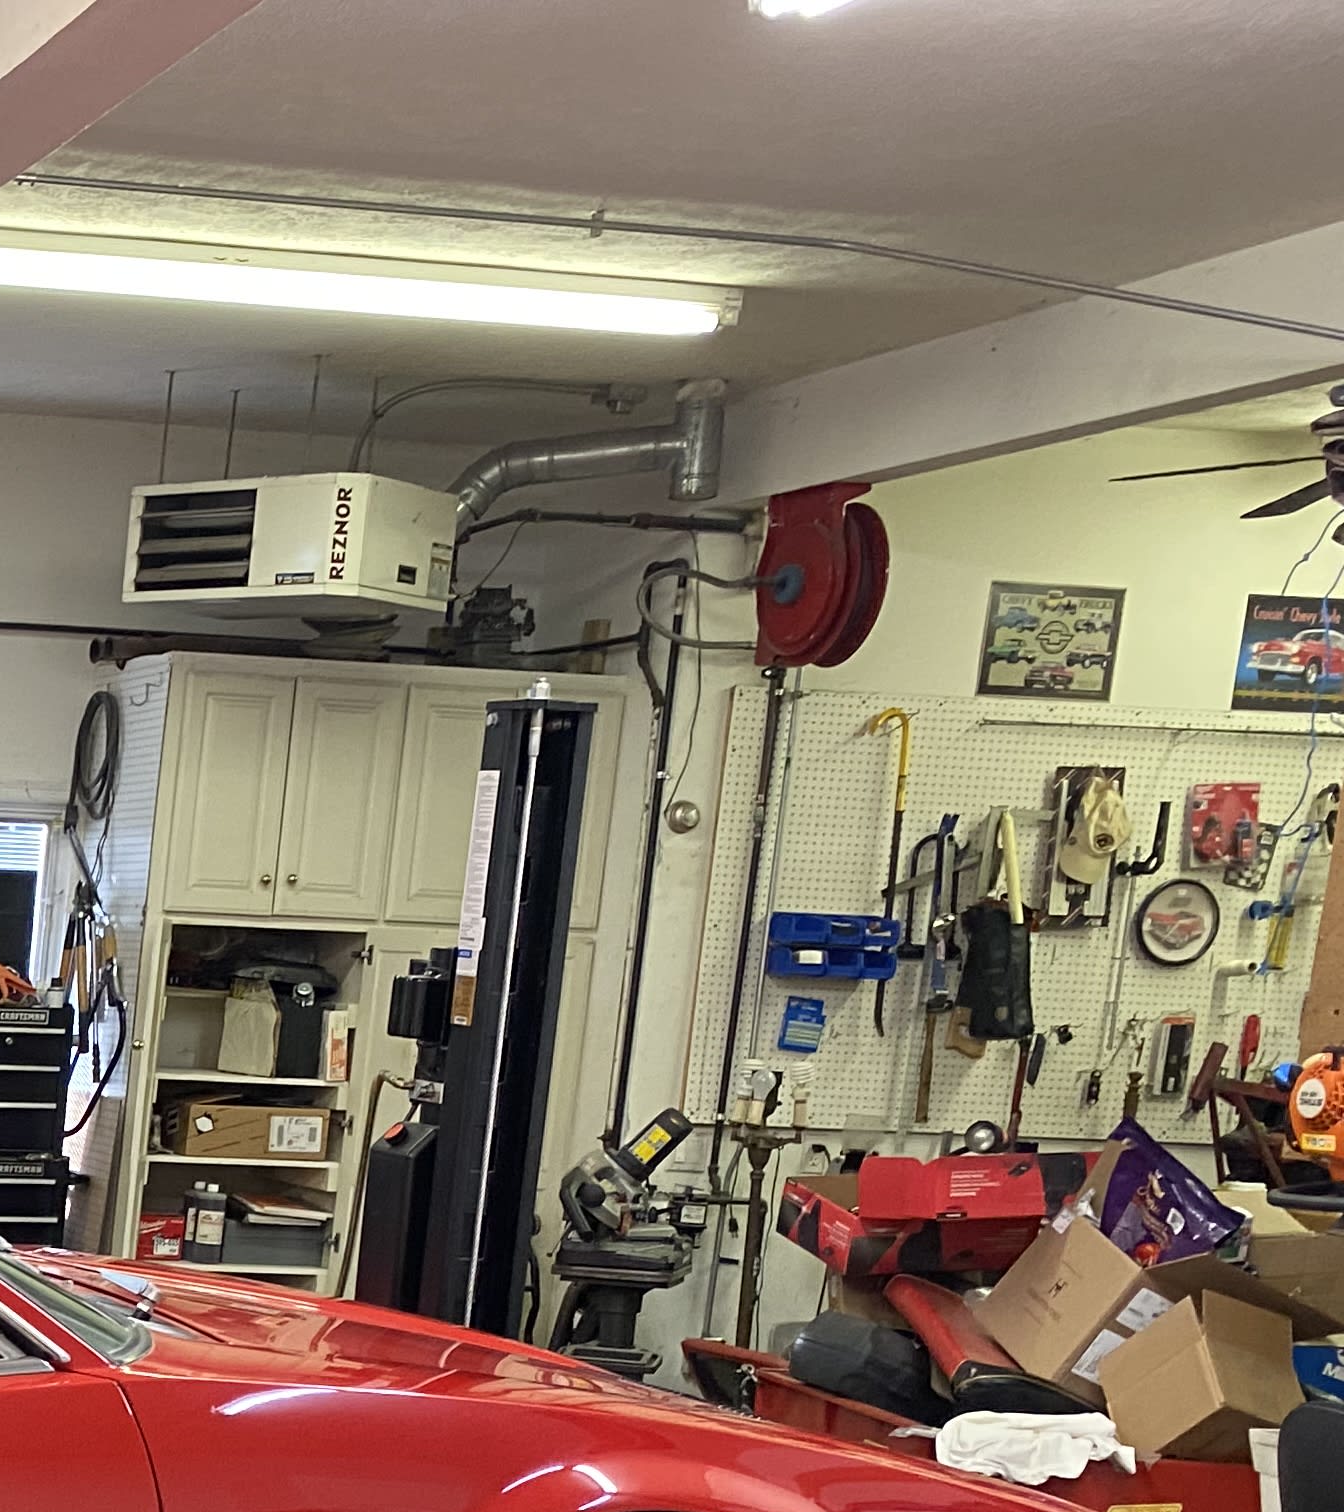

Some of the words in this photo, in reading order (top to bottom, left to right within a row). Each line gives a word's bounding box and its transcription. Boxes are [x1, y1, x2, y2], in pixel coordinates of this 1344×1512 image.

[329, 487, 353, 580] REZNOR
[1291, 607, 1318, 626] Chevy
[0, 1012, 46, 1021] CRAFTSMAN
